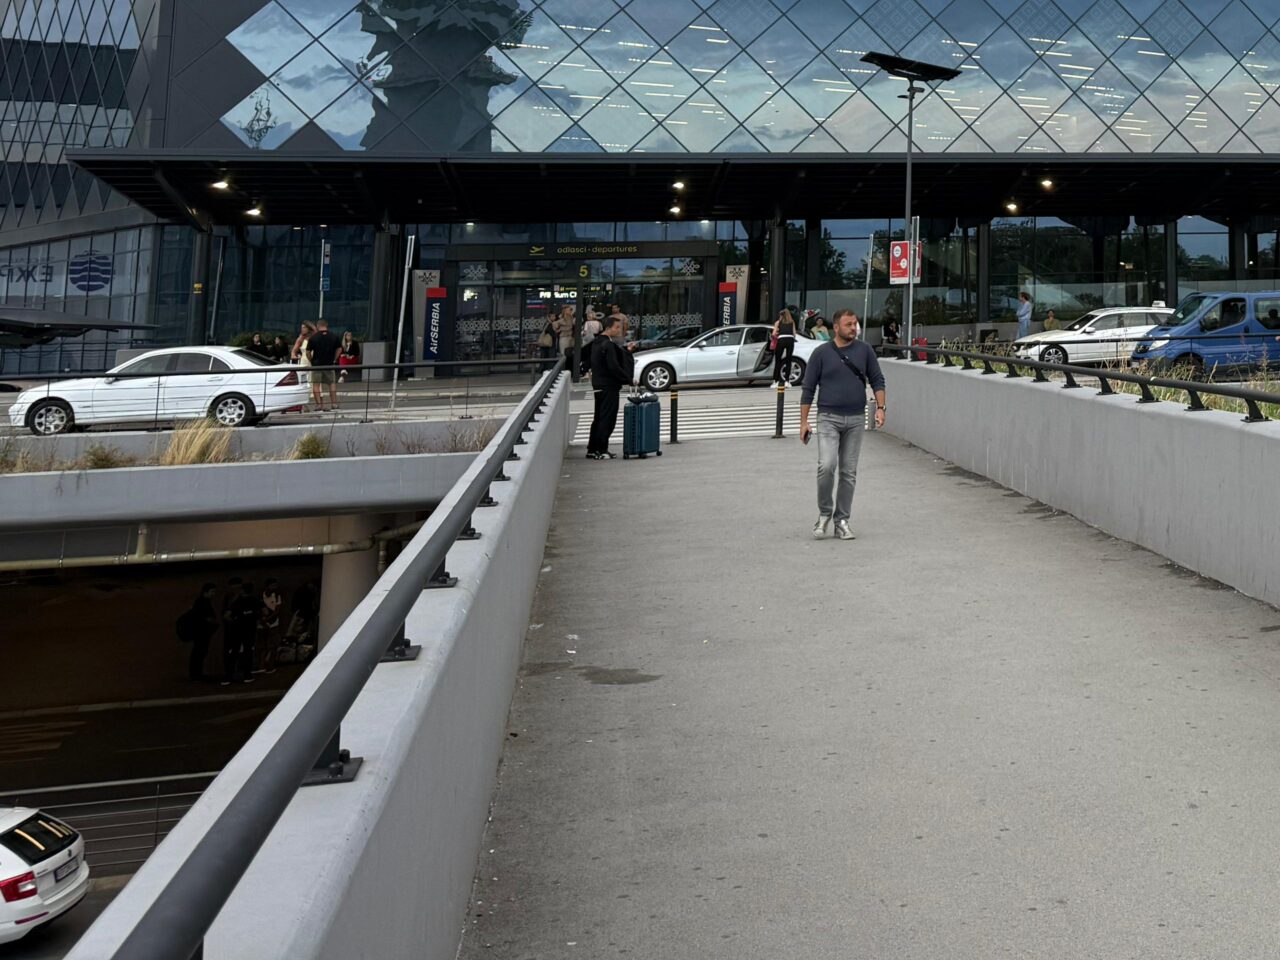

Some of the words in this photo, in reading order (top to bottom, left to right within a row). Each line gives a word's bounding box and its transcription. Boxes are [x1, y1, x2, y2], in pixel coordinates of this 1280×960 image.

[557, 245, 587, 254] odlasci
[592, 245, 638, 254] departures
[579, 265, 588, 278] 5
